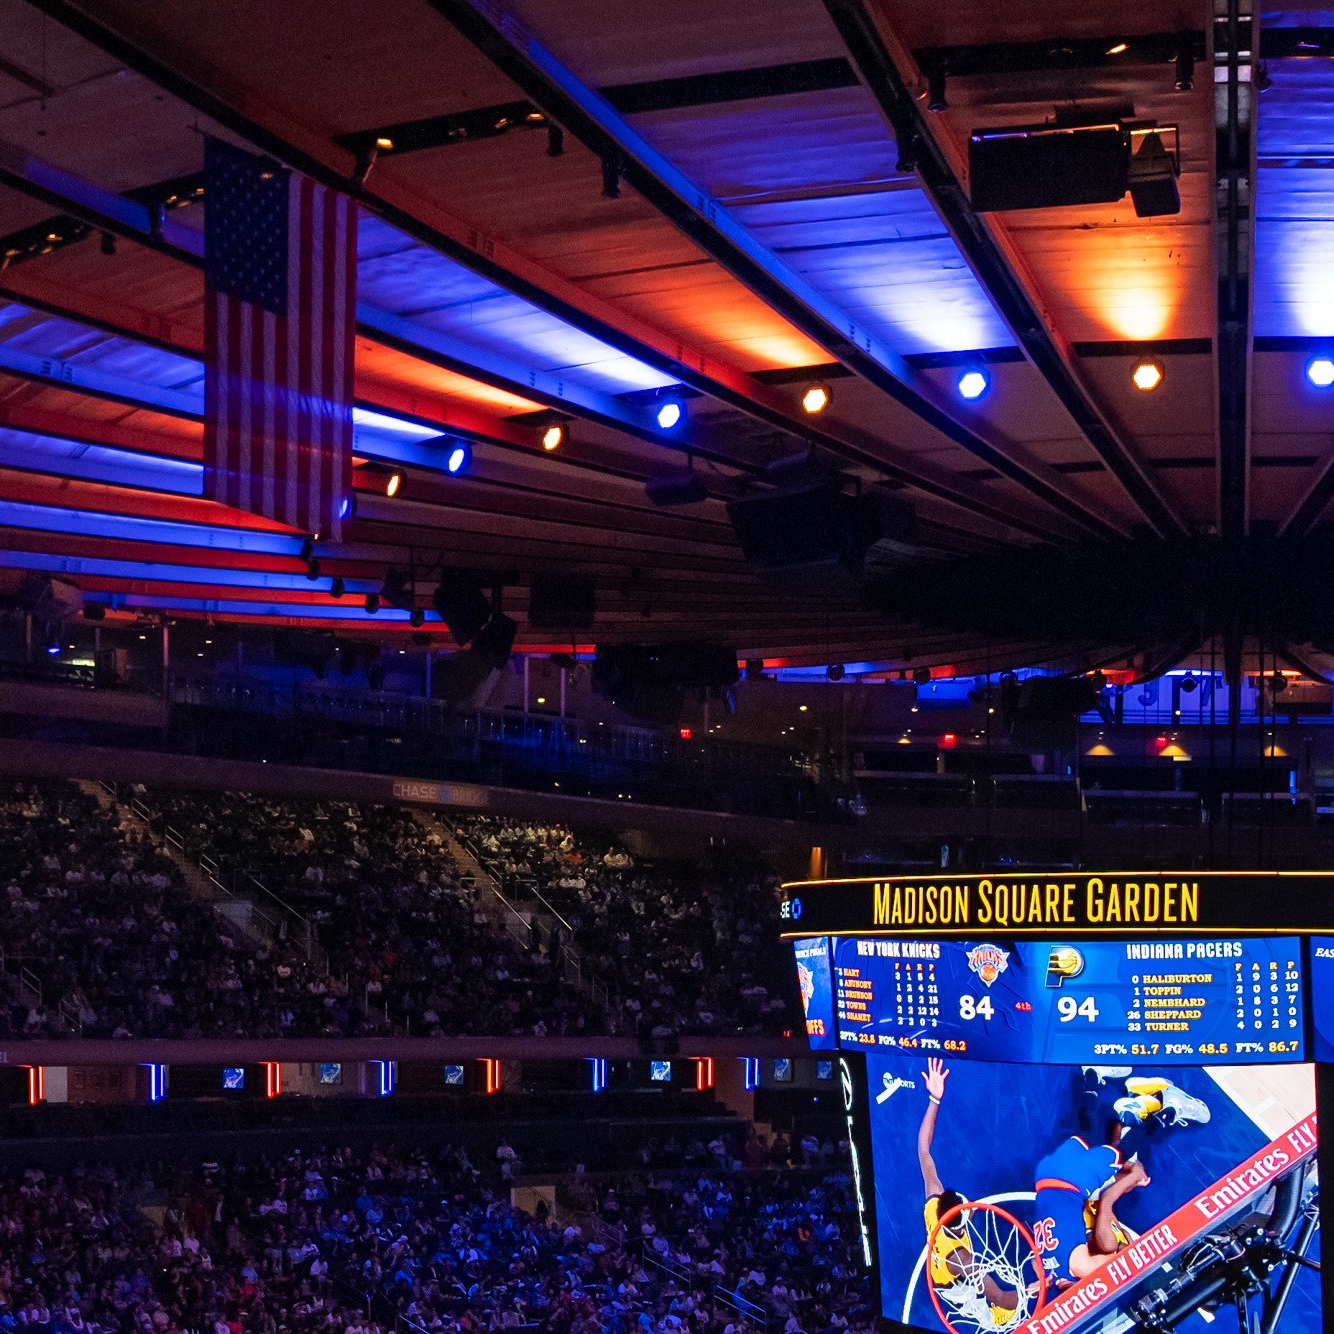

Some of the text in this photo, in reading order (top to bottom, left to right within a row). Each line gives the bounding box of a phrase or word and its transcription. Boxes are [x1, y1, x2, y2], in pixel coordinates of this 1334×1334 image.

[393, 784, 437, 799] CHASE
[873, 878, 1198, 927] MADISON SQUARE GARDEN
[858, 941, 940, 959] NEW YORK KNICKS
[1127, 942, 1243, 959] INDIANA PACERS
[844, 968, 860, 977] HART
[1235, 961, 1295, 971] F A R P
[1132, 971, 1298, 984] 0 HALIBURTON 1 9 3 10
[845, 990, 872, 1000] BRUNSON
[1134, 983, 1298, 996] 1 TOPPIN 2 0 6 12
[846, 1001, 866, 1010] TOWNS
[959, 995, 994, 1020] 84
[1133, 995, 1296, 1008] 2 NEMBHARD 1 8 3 7
[1057, 996, 1099, 1022] 94
[1127, 1007, 1296, 1020] 26 SHEPPARD 2 0 1 0
[847, 1012, 871, 1022] SHAMET
[1128, 1019, 1297, 1032] 33 TURNER 4 0 2 9
[859, 1032, 966, 1050] 23.8 46.4 FT% 68.2
[1094, 1041, 1298, 1055] 3PT% 51.7 FG% 48.5 FT% 86.7
[1194, 1122, 1317, 1219] Emirates FLY
[1107, 1255, 1131, 1285] FLY
[1128, 1224, 1177, 1270] BETTER
